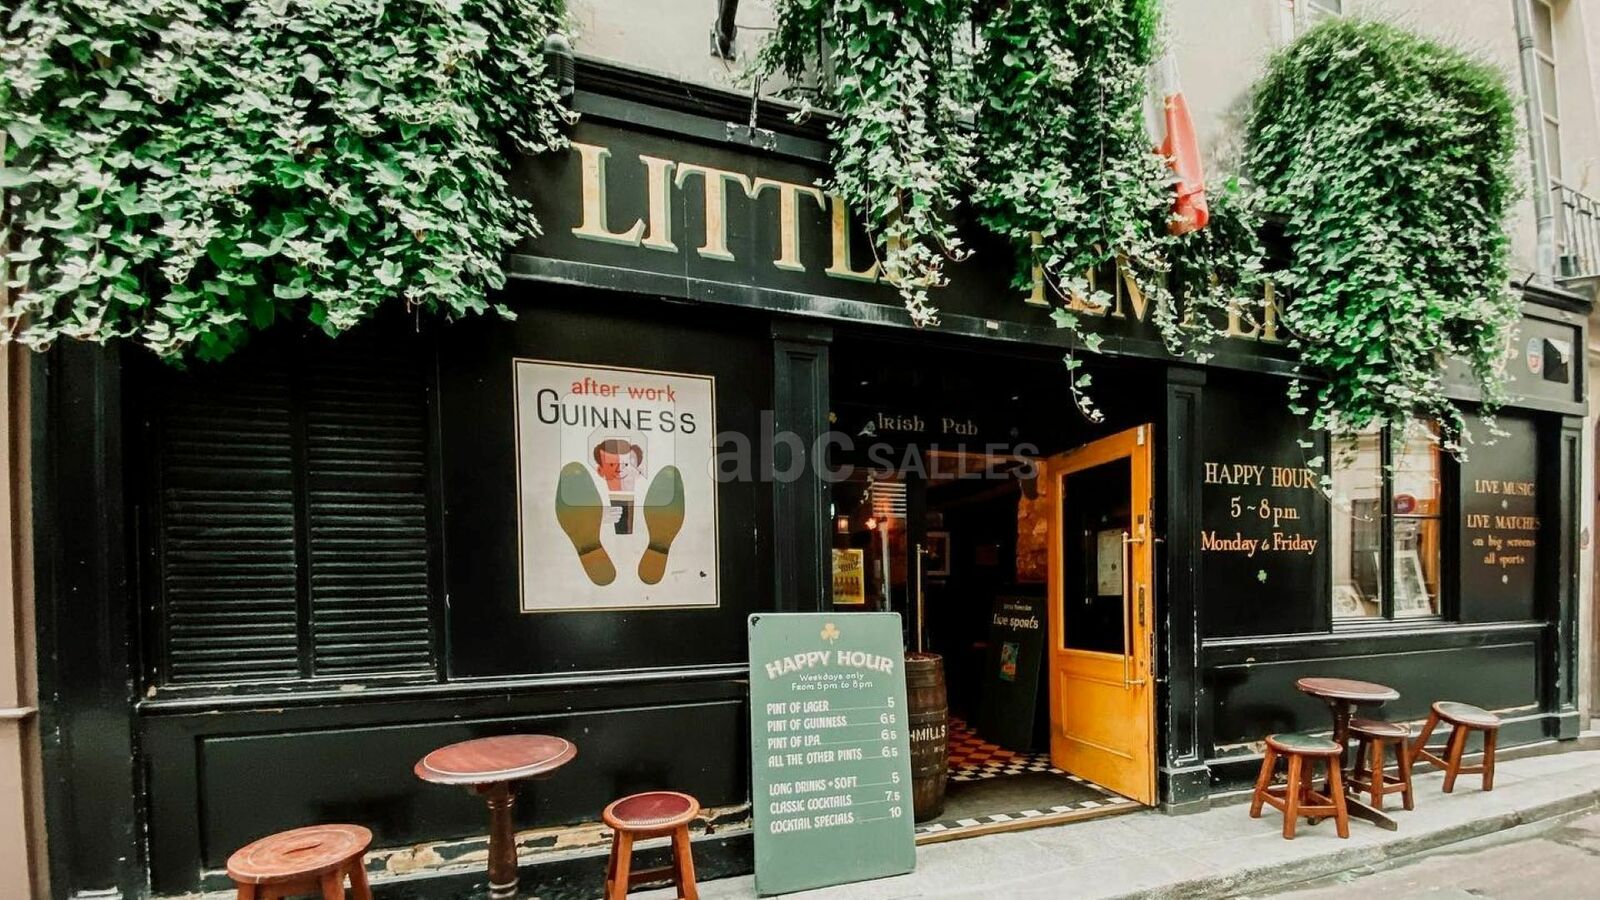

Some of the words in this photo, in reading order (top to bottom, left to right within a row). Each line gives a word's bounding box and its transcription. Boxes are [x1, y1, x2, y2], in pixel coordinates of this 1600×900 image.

[571, 377, 620, 397] after
[628, 385, 676, 402] work
[536, 388, 697, 434] GUINNESS
[878, 412, 925, 432] Irish
[942, 417, 978, 435] Pub
[1204, 462, 1265, 486] HAPPY
[1271, 466, 1317, 489] HOUR
[1475, 479, 1499, 494] LIVE
[1503, 481, 1535, 496] MUSIC
[1467, 514, 1490, 528] LIVE
[1495, 515, 1540, 530] MATCHES
[1201, 531, 1258, 557] Monday
[1272, 532, 1317, 555] Friday
[1484, 552, 1495, 564] all
[765, 651, 831, 680] HAPPY
[837, 650, 894, 675] HOUR
[791, 682, 814, 691] From
[817, 681, 838, 691] 5pm
[852, 681, 873, 690] 8pm
[800, 673, 843, 682] Weekdays
[845, 672, 864, 680] only
[766, 702, 787, 715] PINT
[789, 701, 801, 713] OF
[803, 700, 830, 712] LAGER
[887, 696, 895, 708] 5
[767, 719, 787, 732] PINT
[789, 718, 802, 731] OF
[803, 715, 847, 730] GUINNESS
[767, 737, 788, 750] PINT
[790, 736, 802, 748] OF
[768, 755, 784, 768] ALL
[786, 754, 803, 766] THE
[806, 750, 834, 764] OTHER
[837, 748, 863, 761] PINTS
[769, 782, 792, 796] LONG
[795, 779, 826, 794] DRINKS
[834, 776, 857, 789] SOFT
[892, 771, 900, 784] 5
[770, 800, 805, 815] CLASSIC
[807, 794, 852, 811] COCKTAILS
[770, 817, 812, 834] COCKTAIL
[814, 811, 855, 828] SPECIALS
[889, 806, 901, 819] 10
